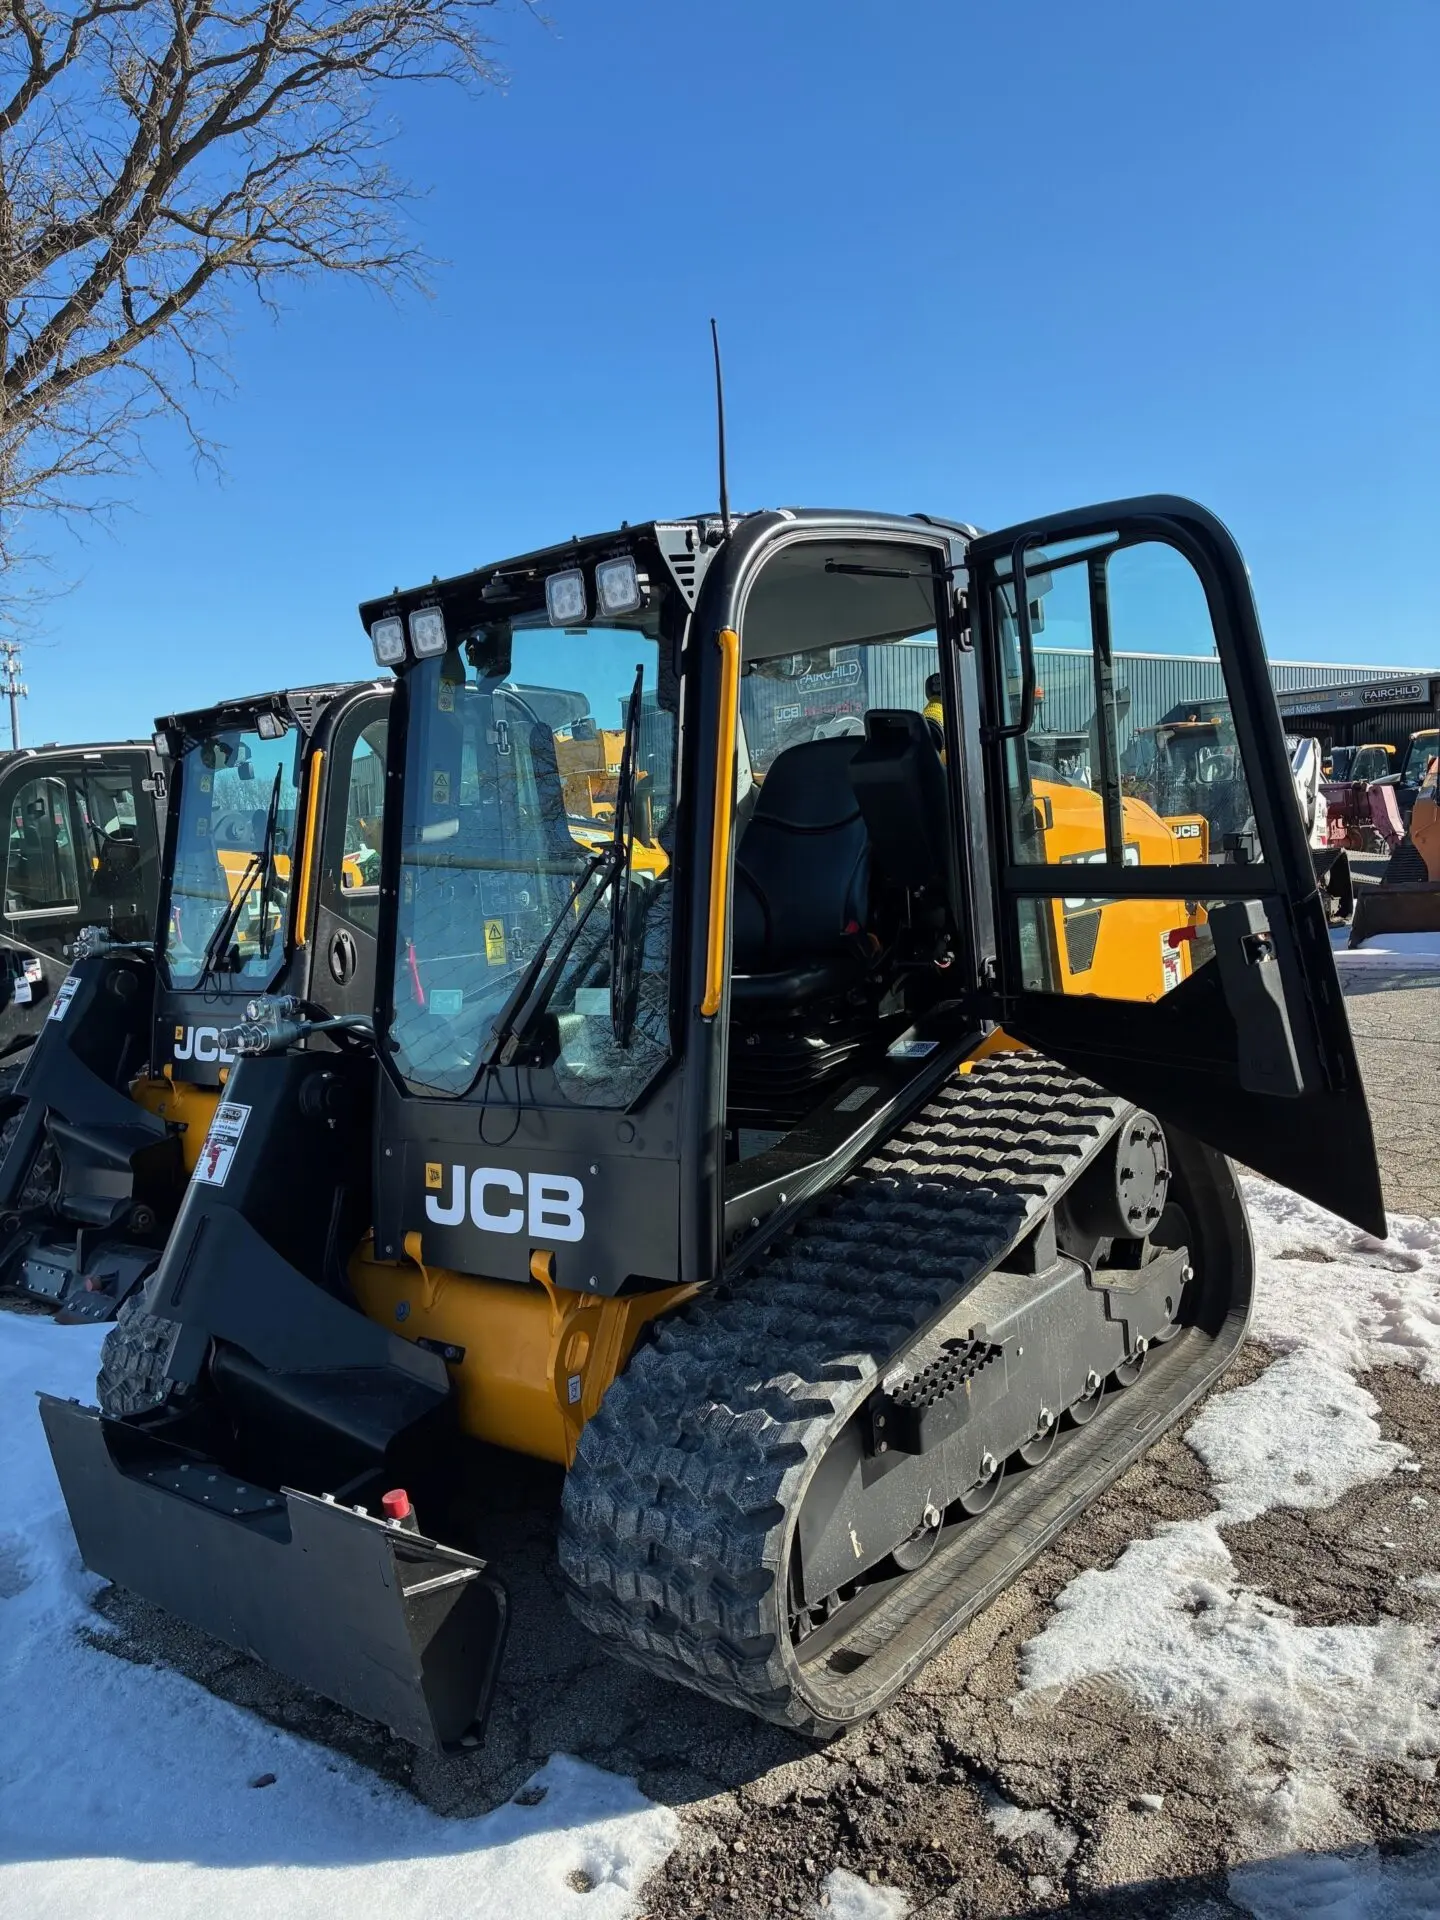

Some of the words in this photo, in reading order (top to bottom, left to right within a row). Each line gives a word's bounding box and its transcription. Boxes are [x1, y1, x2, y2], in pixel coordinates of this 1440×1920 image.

[1364, 685, 1420, 699] FAIRCHILD
[777, 707, 799, 720] JCB
[1296, 703, 1321, 714] Models
[1173, 825, 1200, 838] JCB
[425, 1165, 586, 1242] JCB
